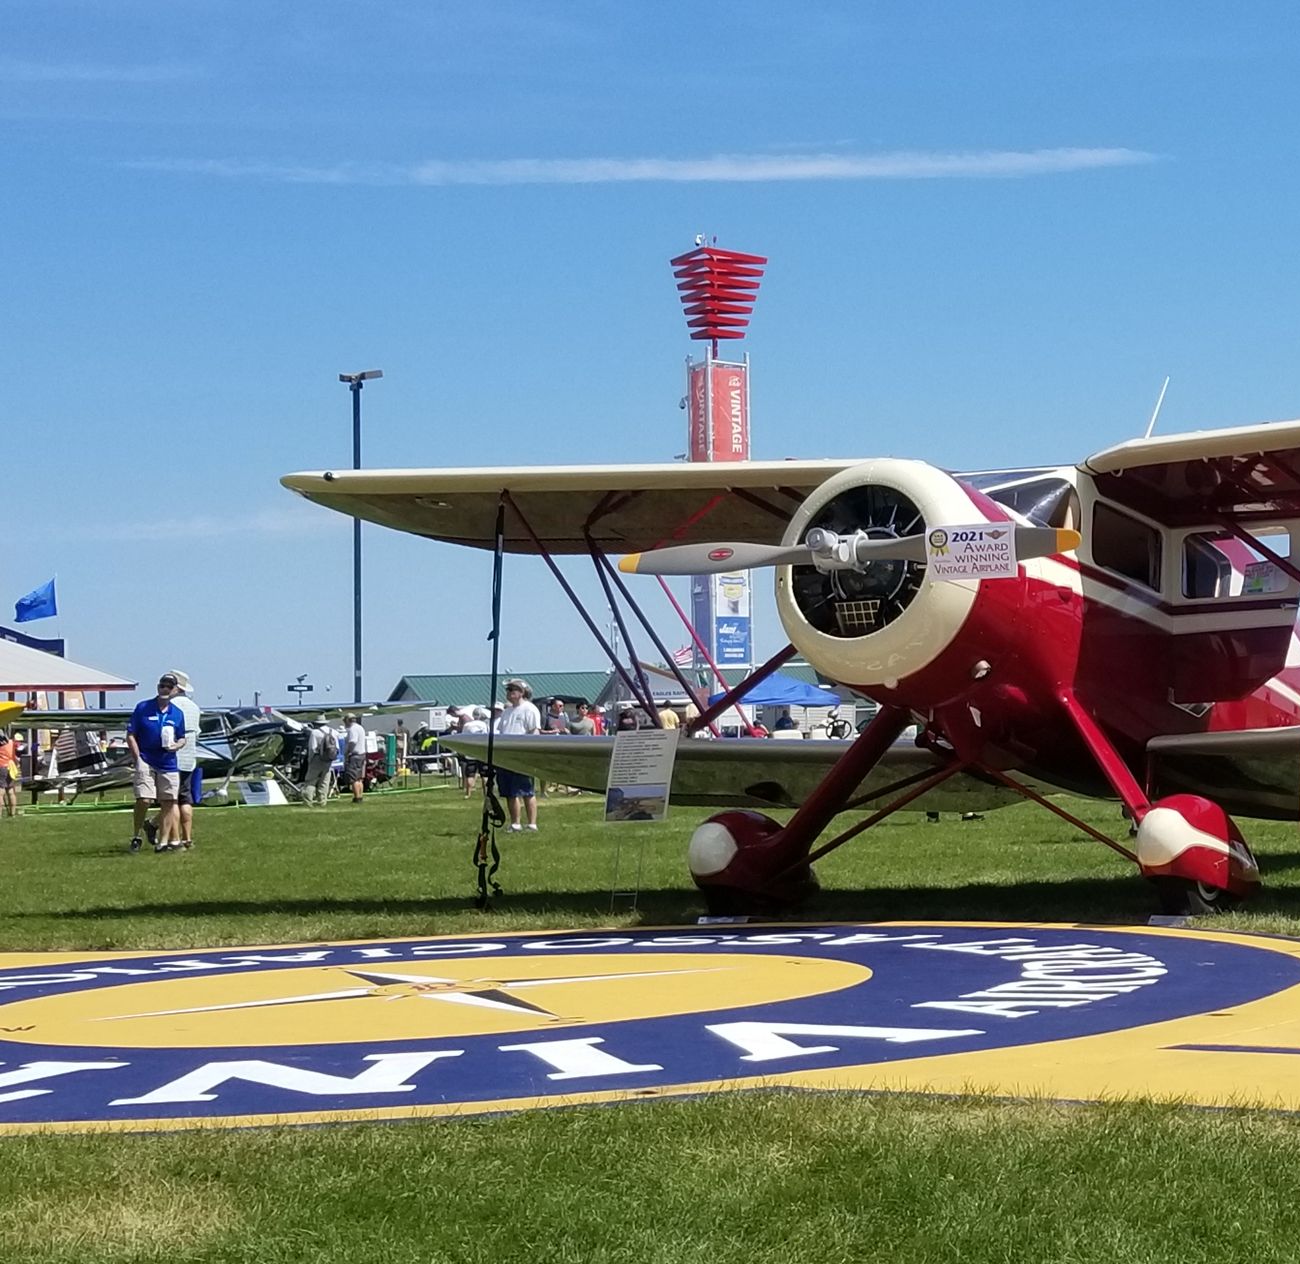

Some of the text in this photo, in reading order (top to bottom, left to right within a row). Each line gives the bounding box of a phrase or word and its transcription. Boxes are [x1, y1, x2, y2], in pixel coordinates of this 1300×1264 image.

[730, 389, 742, 453] VINTAGE
[952, 531, 984, 542] 2021
[963, 542, 1009, 553] AWARD
[954, 552, 1010, 564] WINNING
[934, 562, 1010, 574] VINTAGE AIRPLANE
[0, 933, 1169, 1018] AIRCRAFT ASSOCIATIO
